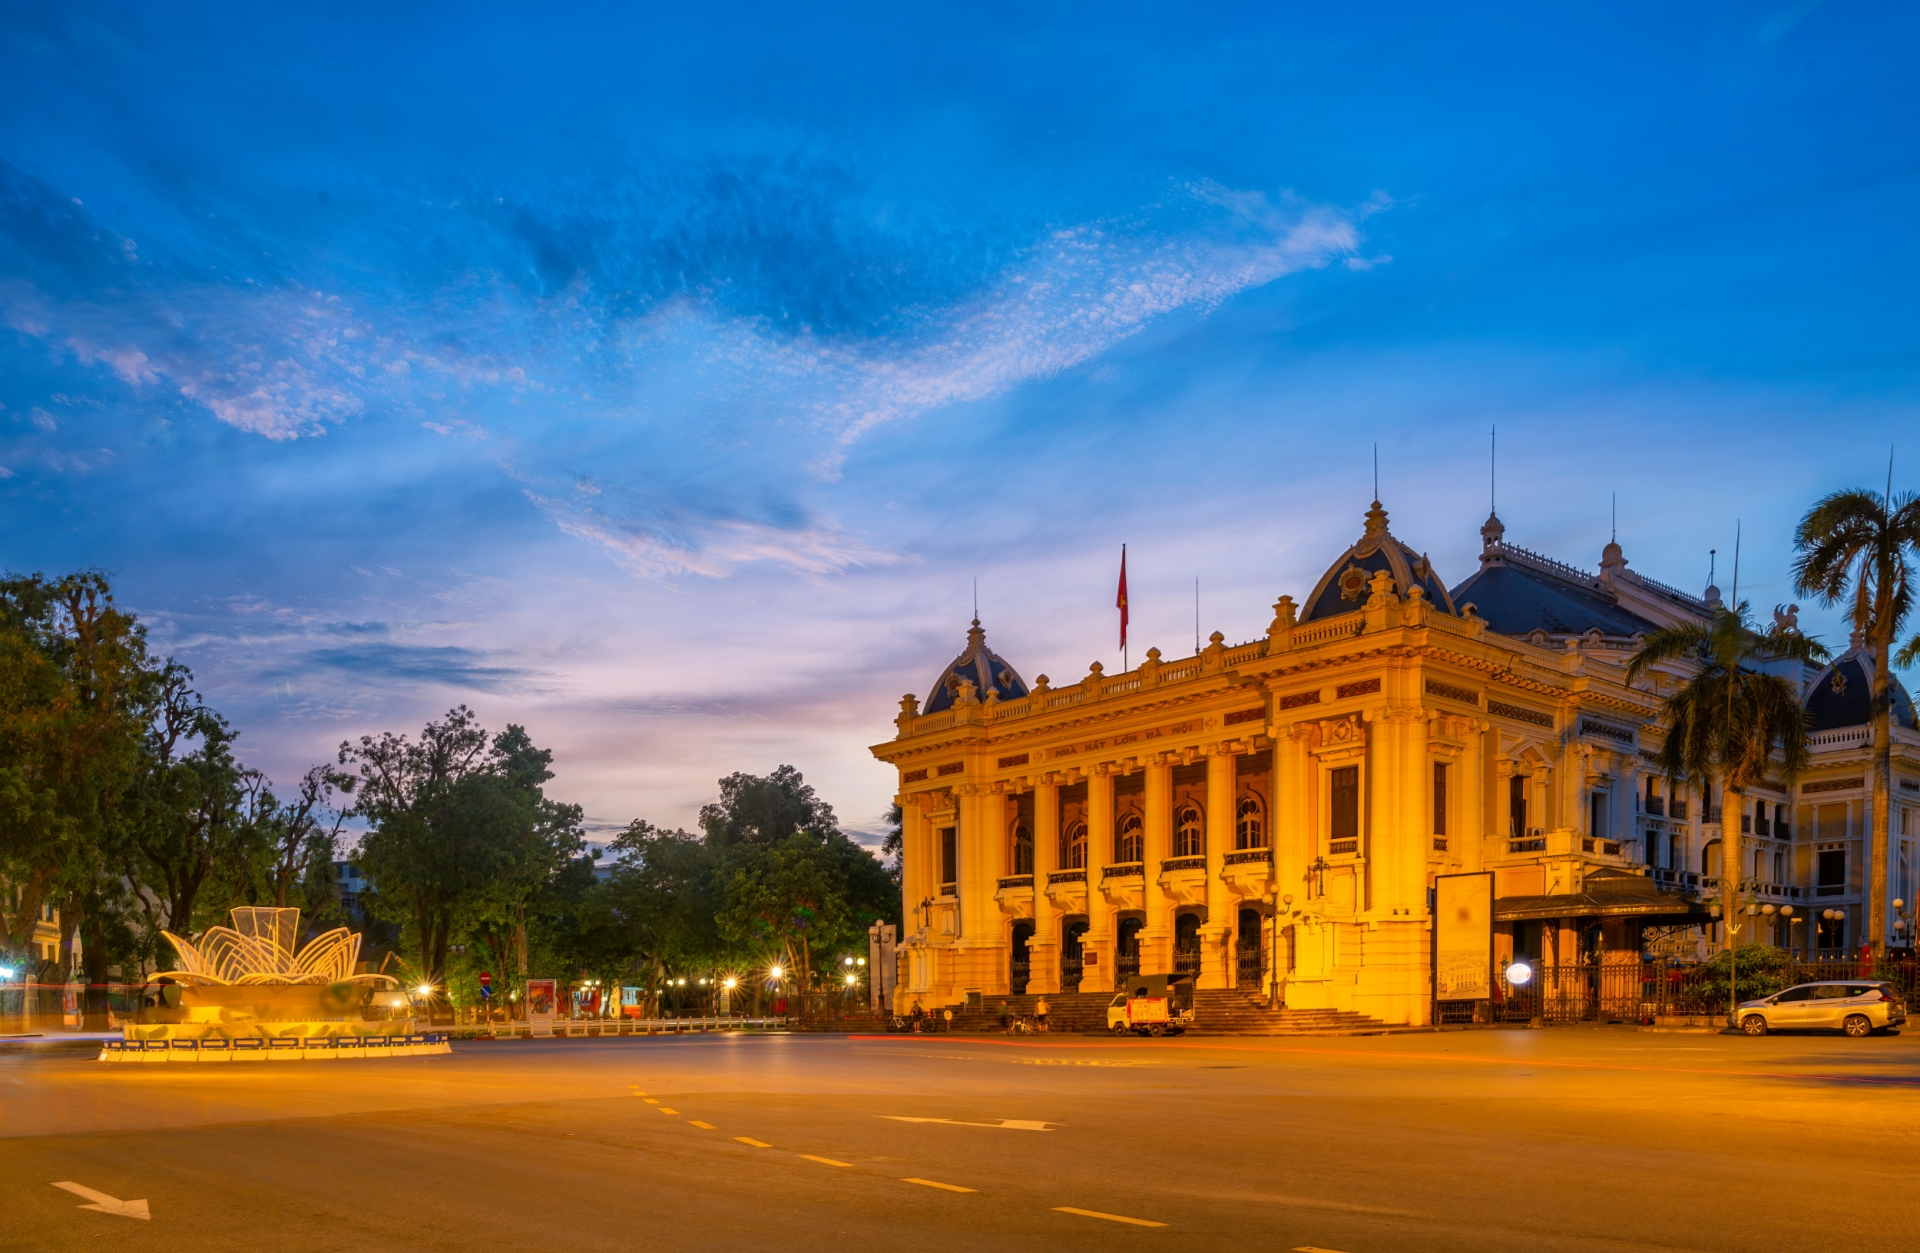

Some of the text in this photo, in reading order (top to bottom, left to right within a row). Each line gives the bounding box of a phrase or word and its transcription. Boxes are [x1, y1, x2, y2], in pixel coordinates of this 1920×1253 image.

[1055, 744, 1077, 757] NHÀ
[1085, 739, 1106, 751] HÁT
[1146, 728, 1162, 740] HÀ
